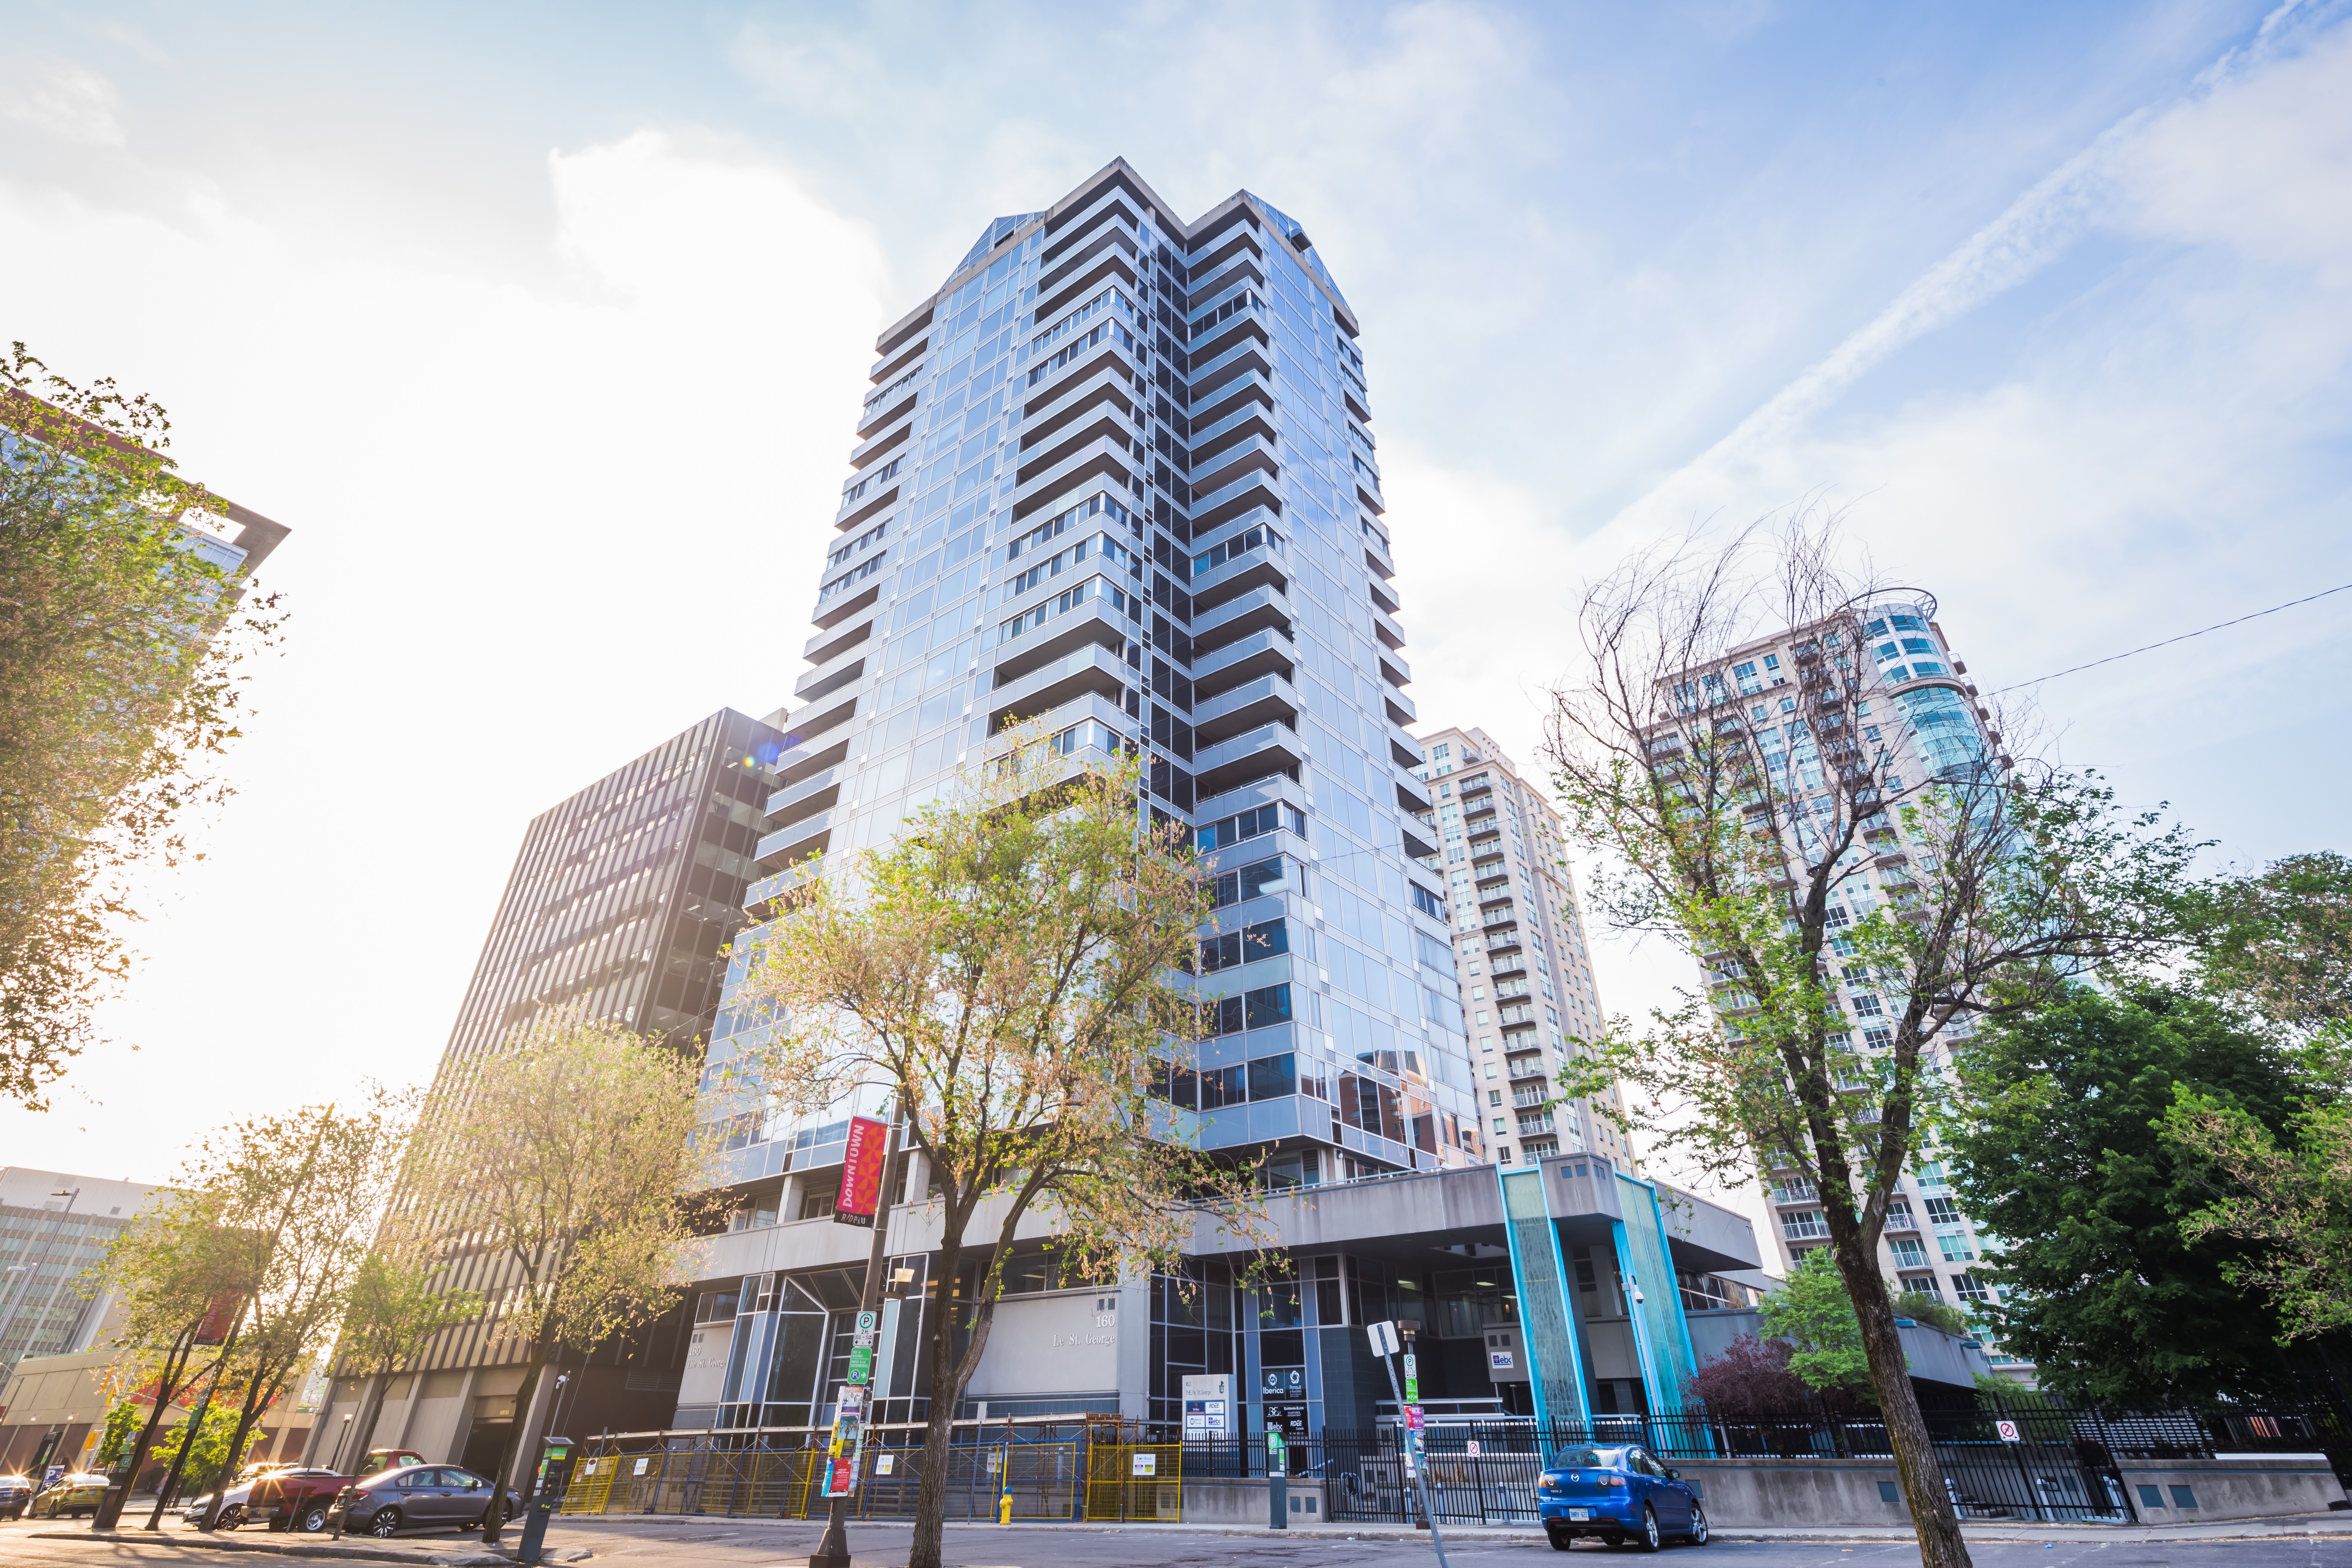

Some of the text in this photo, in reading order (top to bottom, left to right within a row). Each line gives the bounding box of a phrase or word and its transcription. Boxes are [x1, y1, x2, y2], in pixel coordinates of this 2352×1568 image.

[1096, 1314, 1115, 1328] 160
[1053, 1332, 1115, 1347] Le St. George
[689, 1346, 701, 1356] 160
[687, 1359, 697, 1369] The
[709, 1358, 727, 1369] George
[1500, 1355, 1512, 1363] ebc
[1273, 1422, 1283, 1430] ebc
[46, 1470, 56, 1480] P
